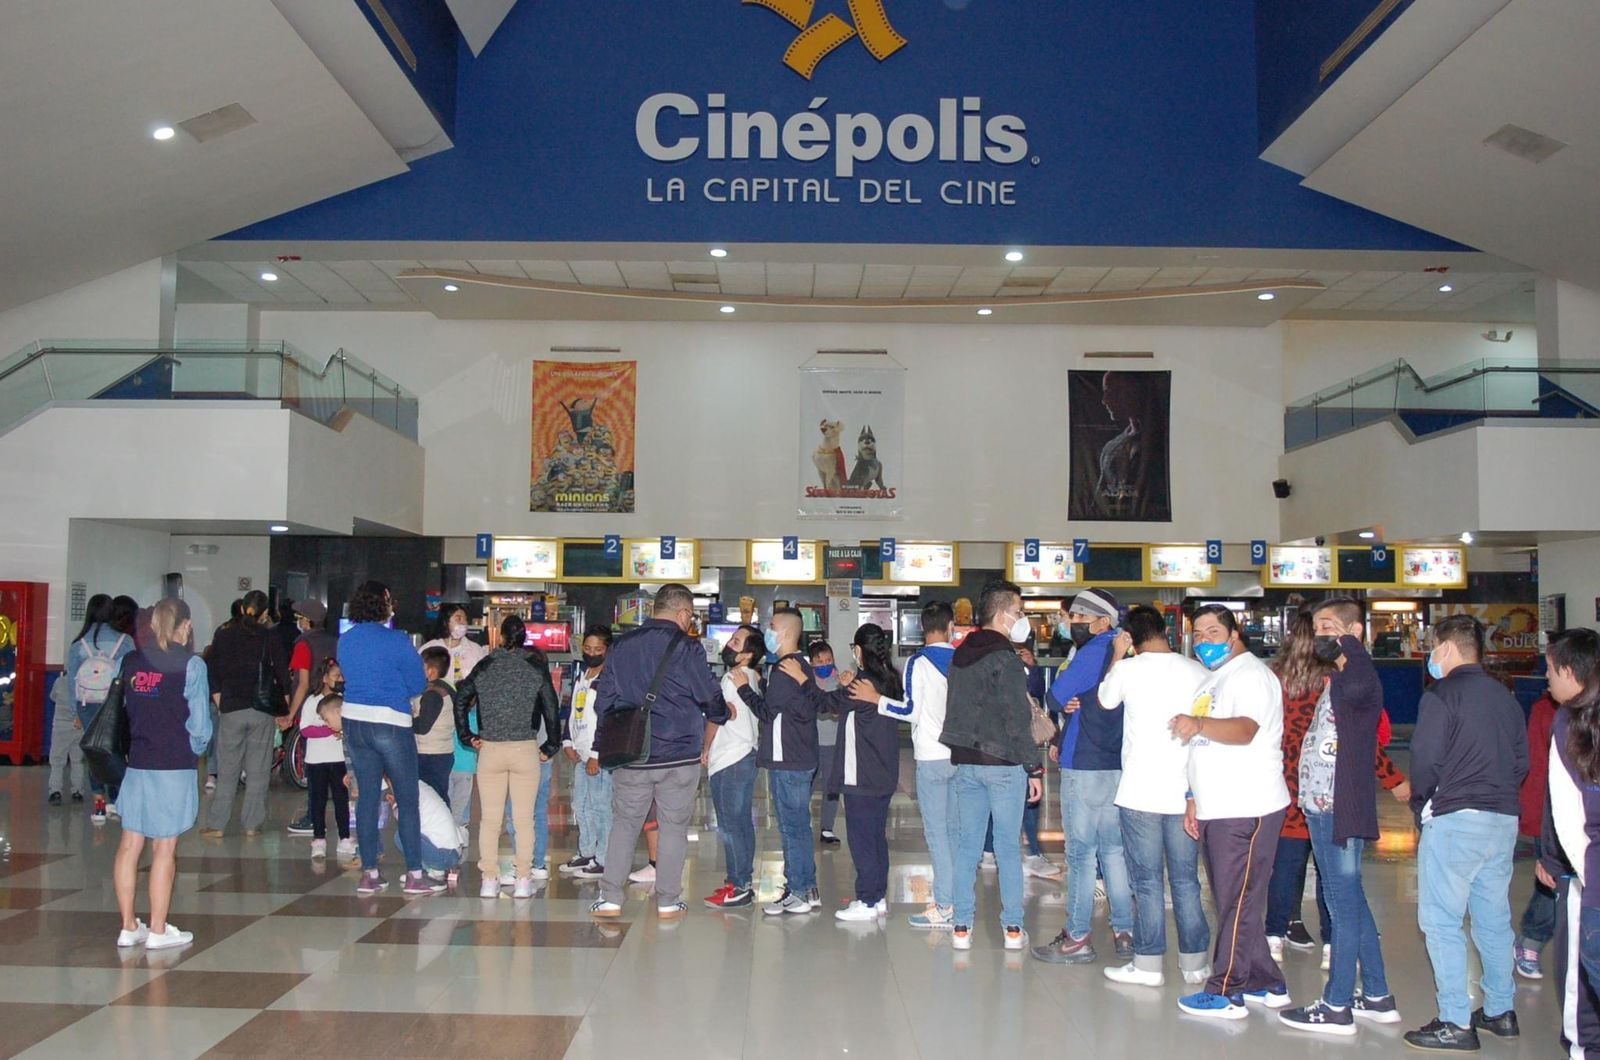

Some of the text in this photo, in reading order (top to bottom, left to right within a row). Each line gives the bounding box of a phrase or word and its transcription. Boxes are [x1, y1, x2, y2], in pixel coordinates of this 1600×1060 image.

[635, 93, 1029, 177] Cinépolis
[646, 178, 1016, 205] LA CAPITAL DEL CINE
[555, 492, 610, 502] minions
[480, 538, 487, 552] 1
[607, 539, 617, 553] 2
[663, 540, 673, 554] 3
[783, 541, 795, 553] 4
[882, 542, 893, 555] 5
[1026, 543, 1037, 557] 6
[1075, 543, 1085, 557] 7
[1208, 544, 1219, 558] 8
[1252, 544, 1264, 558] 9
[1372, 550, 1386, 561] 10
